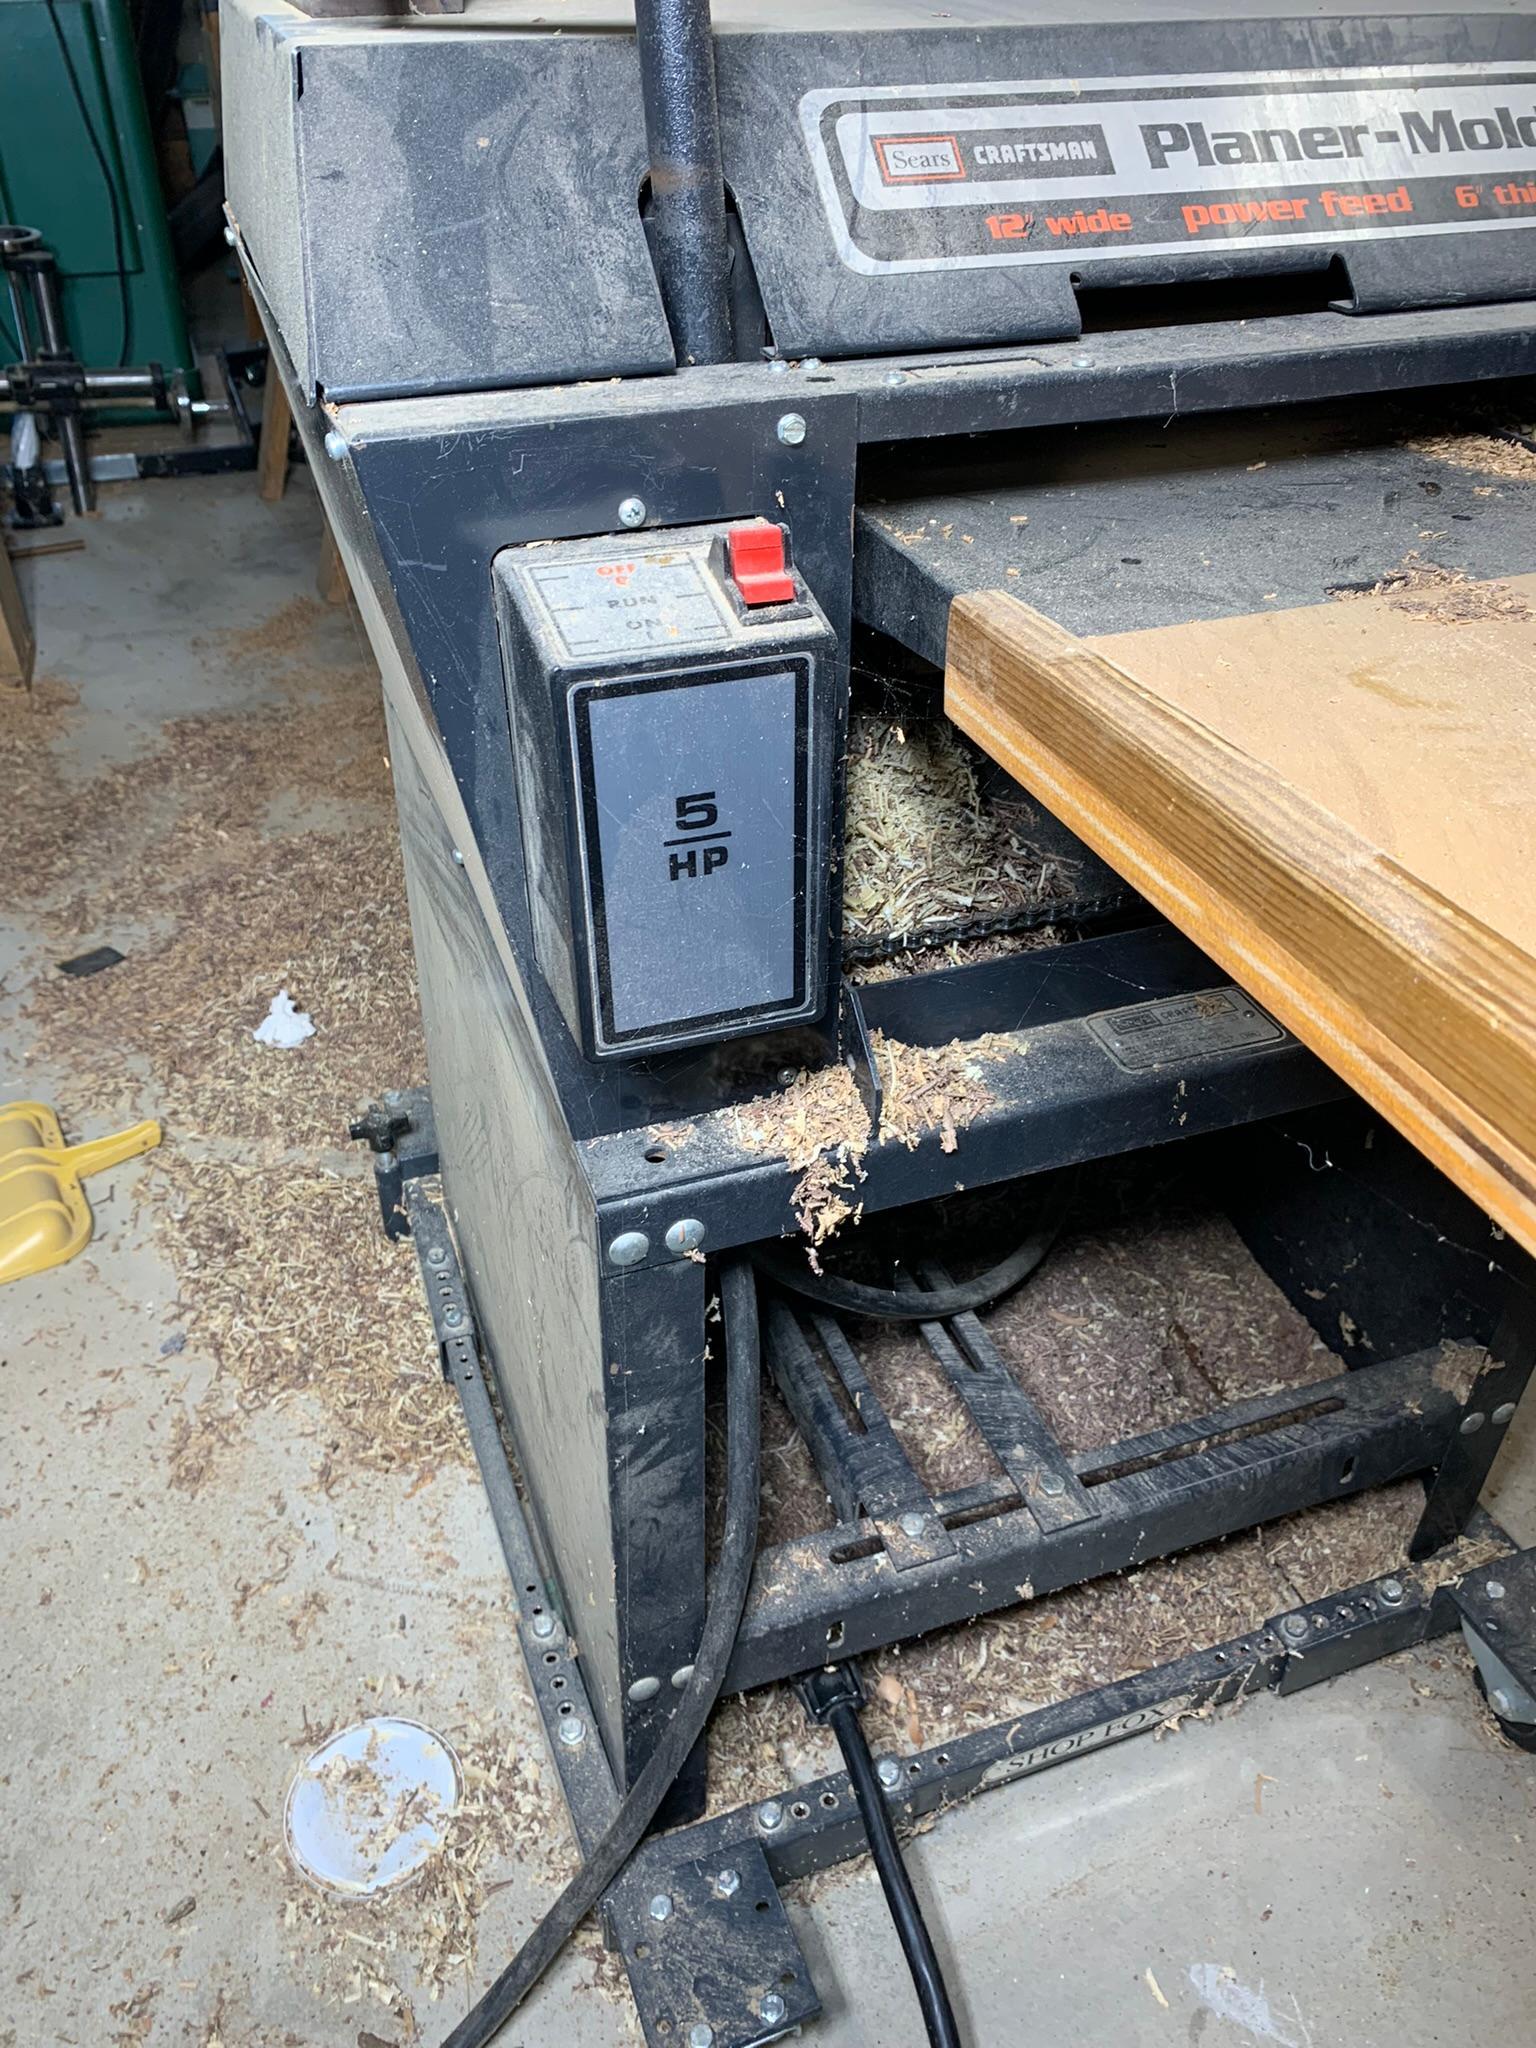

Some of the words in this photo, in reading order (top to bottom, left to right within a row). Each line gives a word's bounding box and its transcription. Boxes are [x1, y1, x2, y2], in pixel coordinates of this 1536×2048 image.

[892, 150, 951, 169] Sears
[973, 140, 1098, 165] CRAFTSMAN
[1045, 208, 1133, 236] wide
[1181, 197, 1309, 234] power
[1318, 185, 1414, 217] feed
[607, 594, 657, 609] RUN
[626, 618, 662, 630] ON
[675, 791, 718, 831] 5
[669, 845, 729, 881] HP
[1006, 1731, 1094, 1773] SHOP
[1103, 1708, 1166, 1738] FOX
